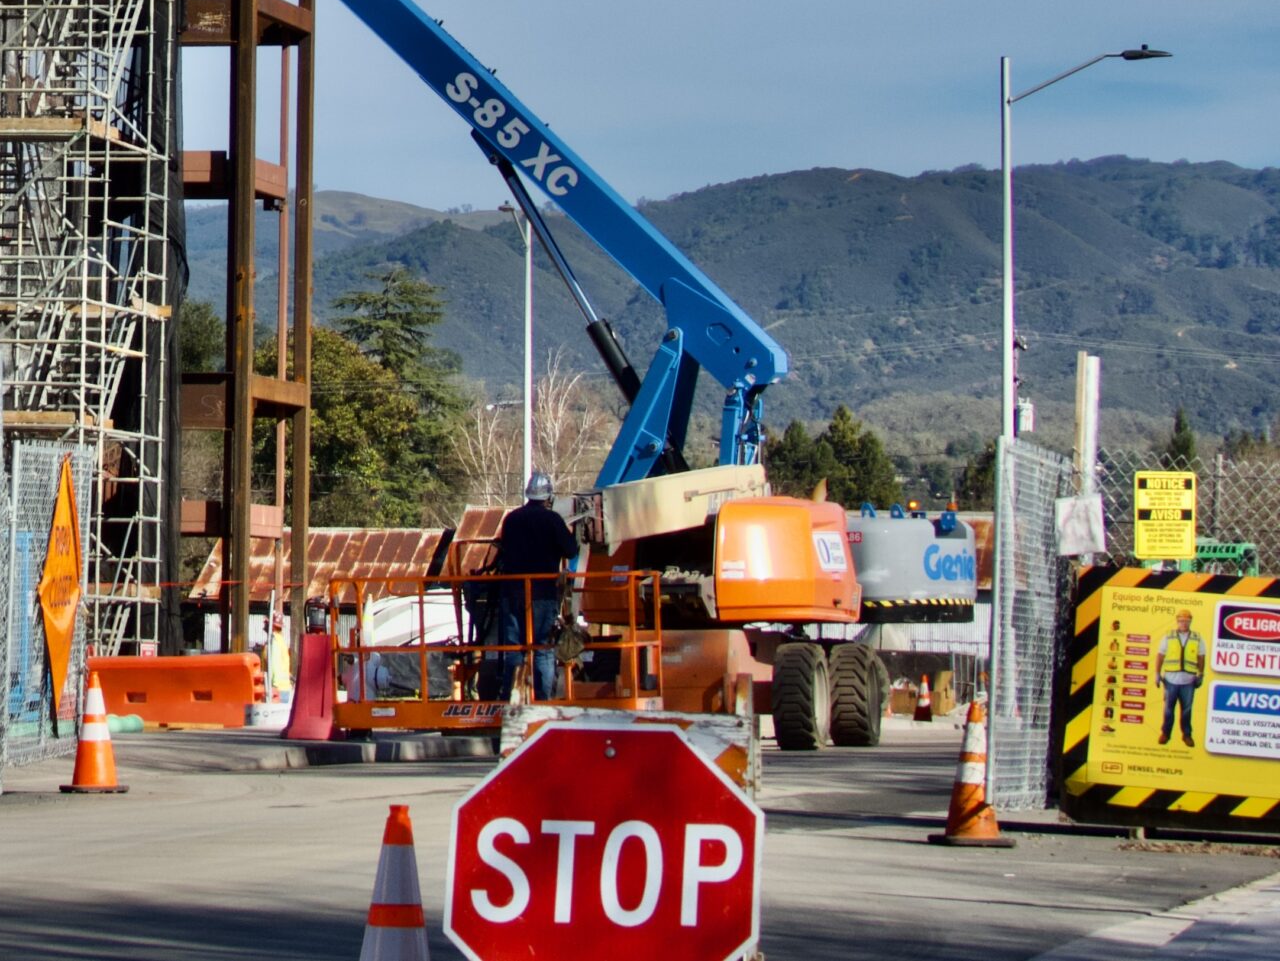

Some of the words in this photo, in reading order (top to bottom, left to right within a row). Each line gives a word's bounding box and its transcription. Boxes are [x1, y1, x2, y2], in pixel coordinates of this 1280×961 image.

[445, 72, 531, 149] S-85
[520, 141, 578, 196] XC
[1146, 478, 1185, 489] NOTICE
[1150, 509, 1182, 520] AVISO
[923, 543, 974, 580] Genie
[1112, 592, 1142, 602] Equipo
[1143, 594, 1154, 602] de
[1111, 603, 1149, 612] Personal
[1151, 605, 1176, 615] (PPE)
[1216, 650, 1240, 667] NO
[1226, 691, 1280, 710] AVISO
[443, 703, 473, 717] JLG
[1211, 716, 1235, 725] TODOS
[1227, 738, 1257, 747] OFICINA
[1259, 741, 1273, 749] DEL
[1127, 764, 1154, 773] HENSEL
[1156, 766, 1183, 776] PHELPS
[470, 816, 744, 927] STOP
